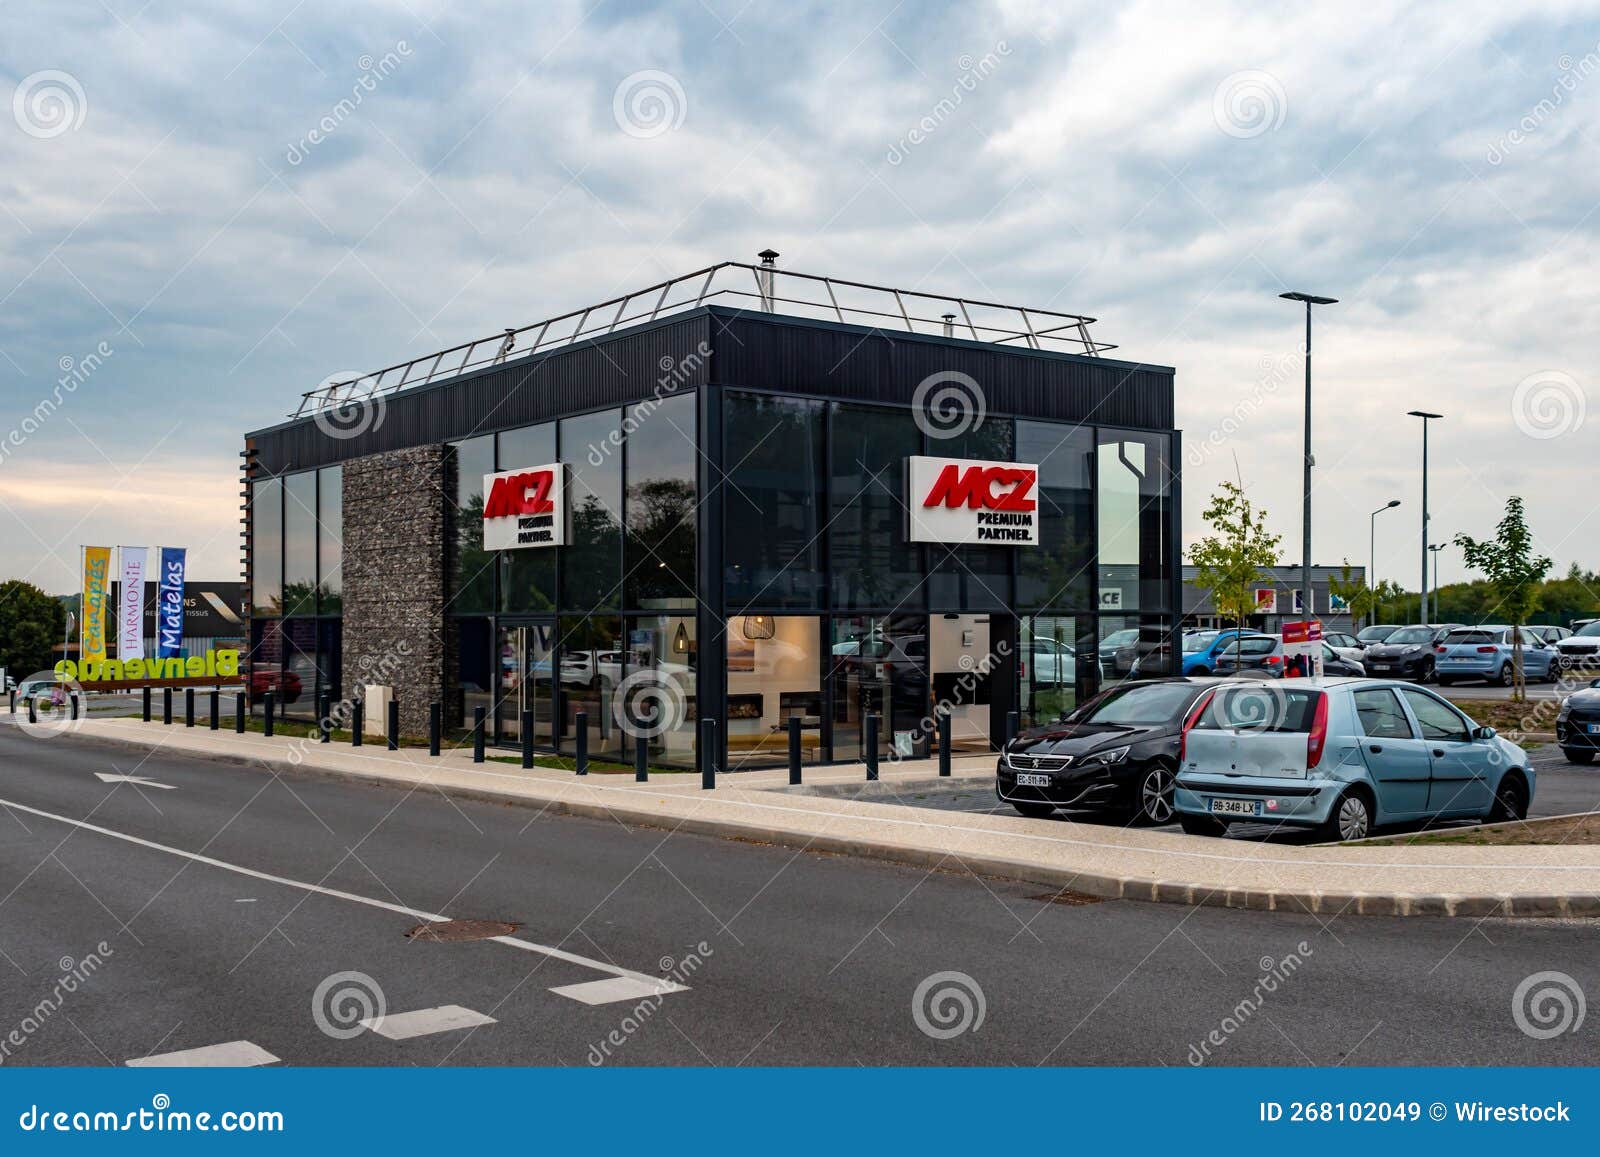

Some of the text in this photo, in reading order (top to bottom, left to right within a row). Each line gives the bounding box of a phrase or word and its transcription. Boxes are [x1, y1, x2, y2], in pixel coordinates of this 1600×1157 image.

[484, 470, 554, 519] MCZ
[922, 464, 1036, 511] MCZ
[977, 512, 1033, 526] PREMIUM
[161, 561, 184, 649] Matelas
